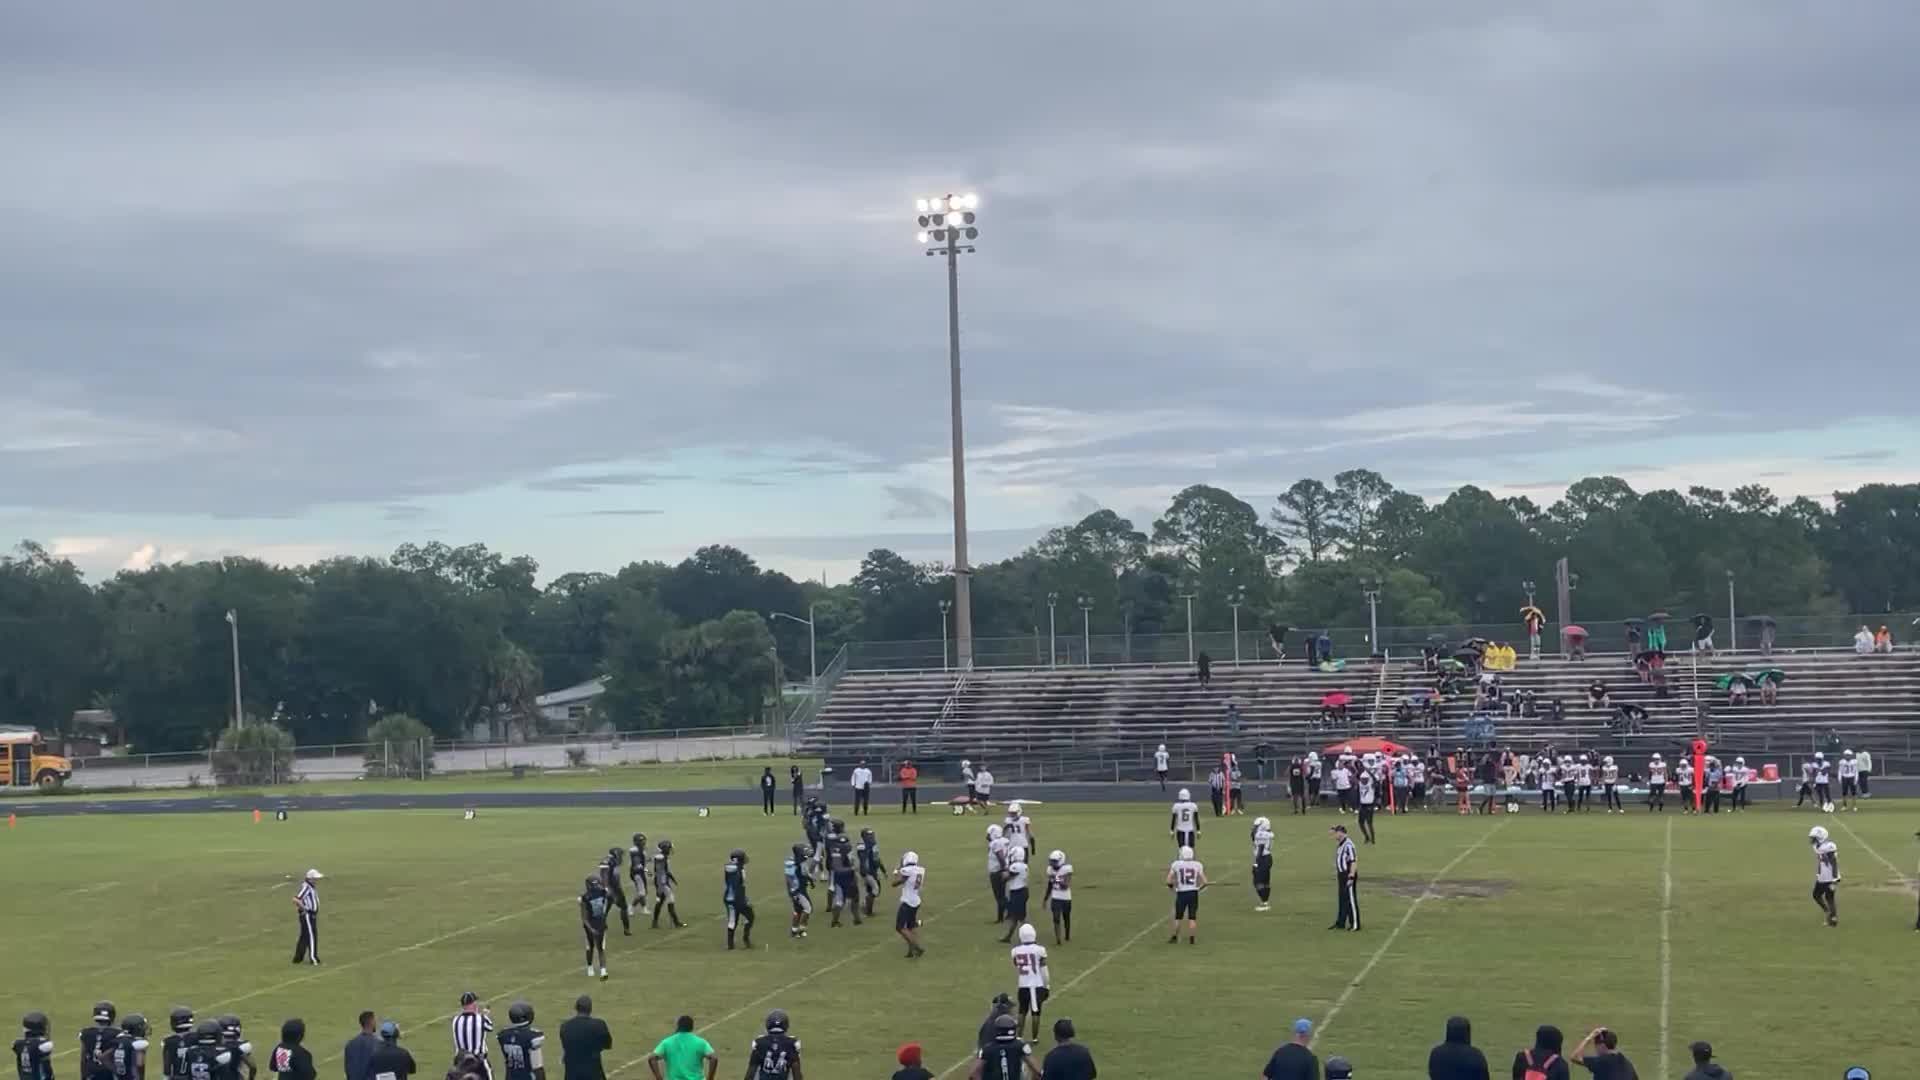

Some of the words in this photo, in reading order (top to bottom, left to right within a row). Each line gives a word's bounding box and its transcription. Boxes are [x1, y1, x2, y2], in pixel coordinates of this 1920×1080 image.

[1182, 808, 1190, 821] 6
[1179, 867, 1196, 885] 12
[1015, 953, 1037, 975] 21
